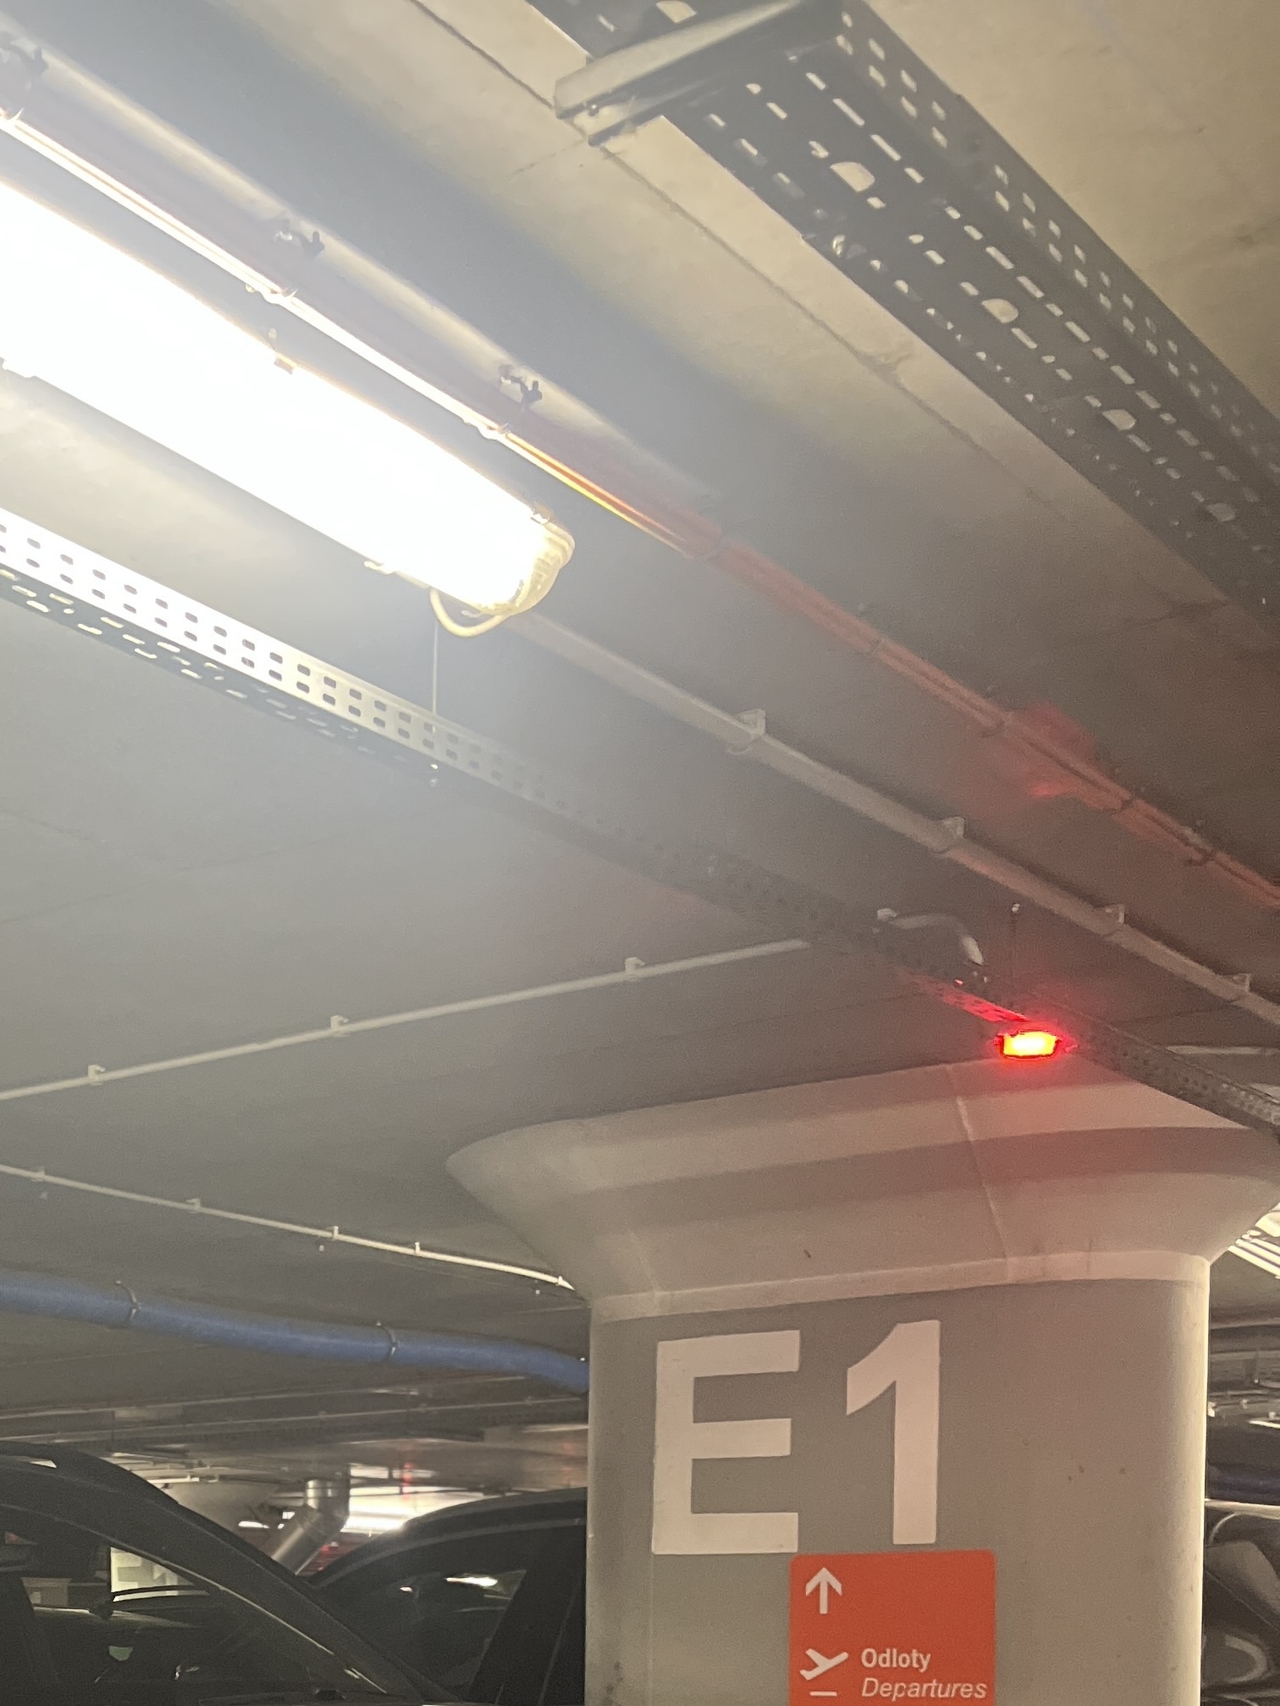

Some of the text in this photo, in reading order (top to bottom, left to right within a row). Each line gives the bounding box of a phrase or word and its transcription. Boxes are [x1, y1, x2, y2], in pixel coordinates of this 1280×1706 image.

[652, 1320, 941, 1555] E1
[861, 1648, 931, 1673] Odloty
[861, 1677, 988, 1702] Departures
